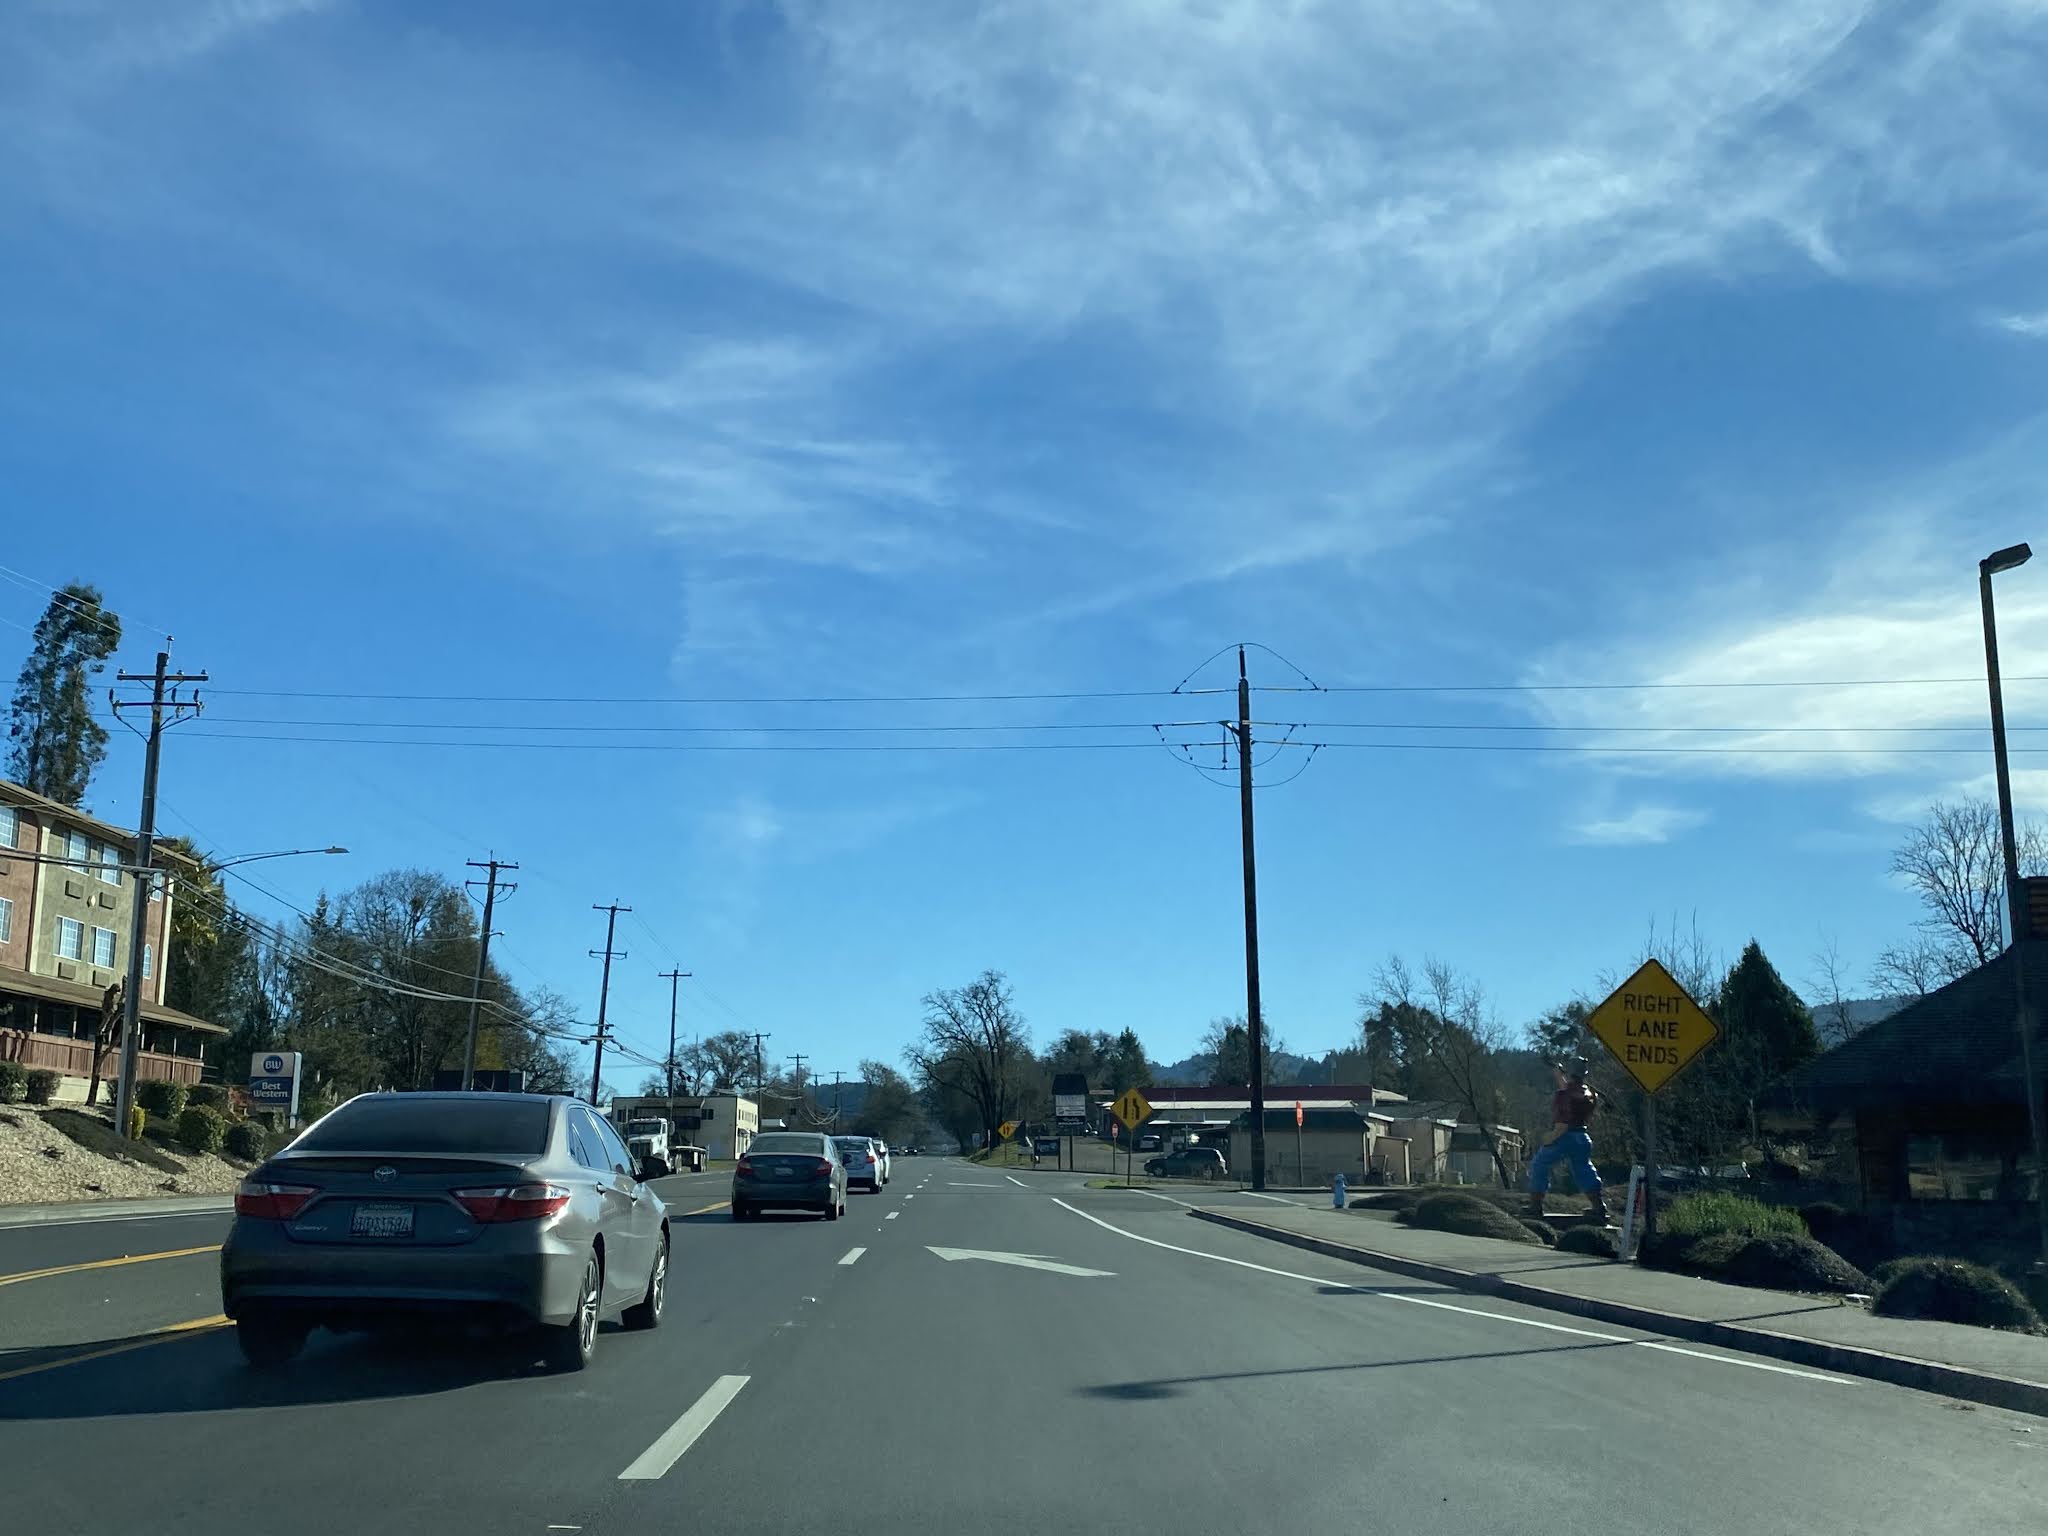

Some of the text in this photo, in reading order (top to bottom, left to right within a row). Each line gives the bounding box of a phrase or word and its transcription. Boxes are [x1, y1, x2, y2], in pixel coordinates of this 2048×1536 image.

[1623, 993, 1684, 1014] RIGHT
[1625, 1019, 1680, 1040] LANE
[1626, 1044, 1679, 1065] ENDS
[265, 1060, 281, 1070] BW
[261, 1082, 281, 1090] Best
[253, 1090, 288, 1098] Western
